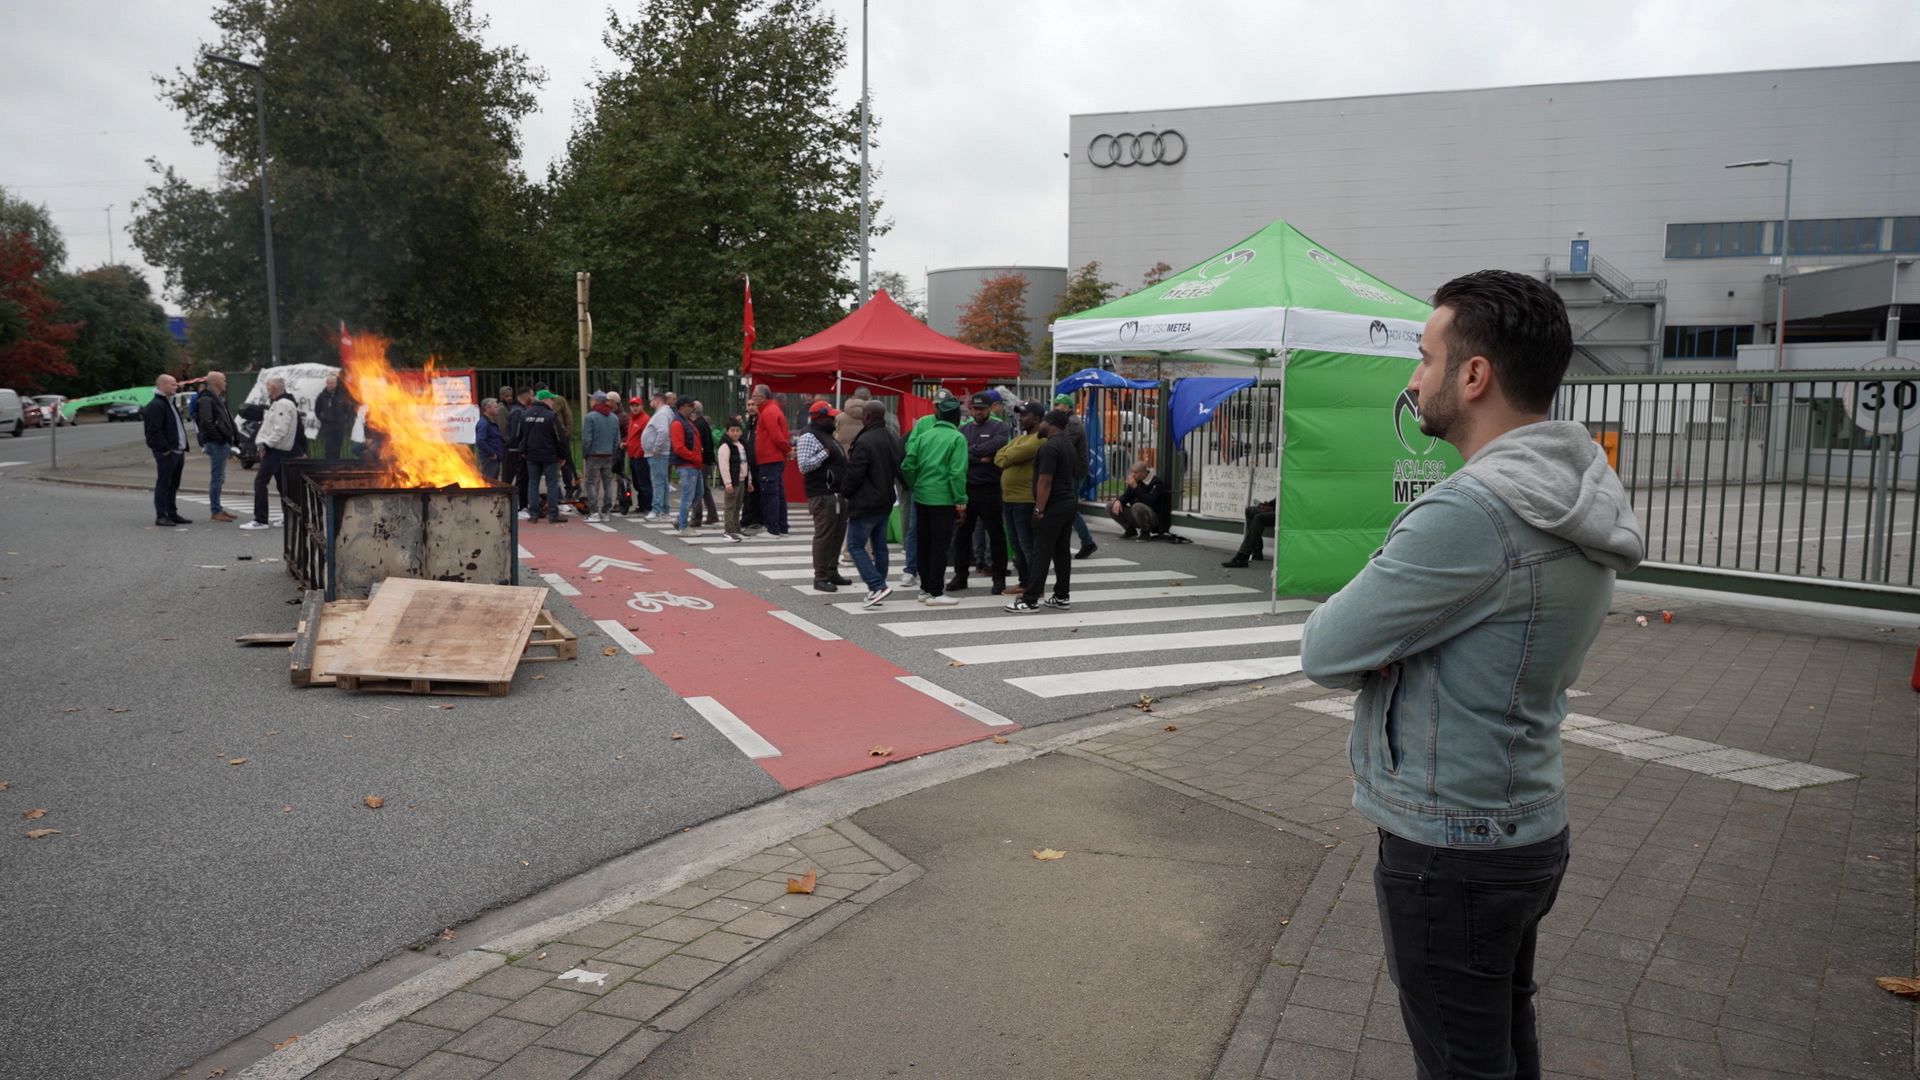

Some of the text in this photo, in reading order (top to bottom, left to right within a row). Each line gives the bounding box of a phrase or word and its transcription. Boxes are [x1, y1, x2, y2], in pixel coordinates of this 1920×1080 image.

[1167, 322, 1191, 332] METEA
[1862, 382, 1917, 411] 30
[1394, 460, 1446, 480] ACV-CSC
[1394, 480, 1436, 503] MET
